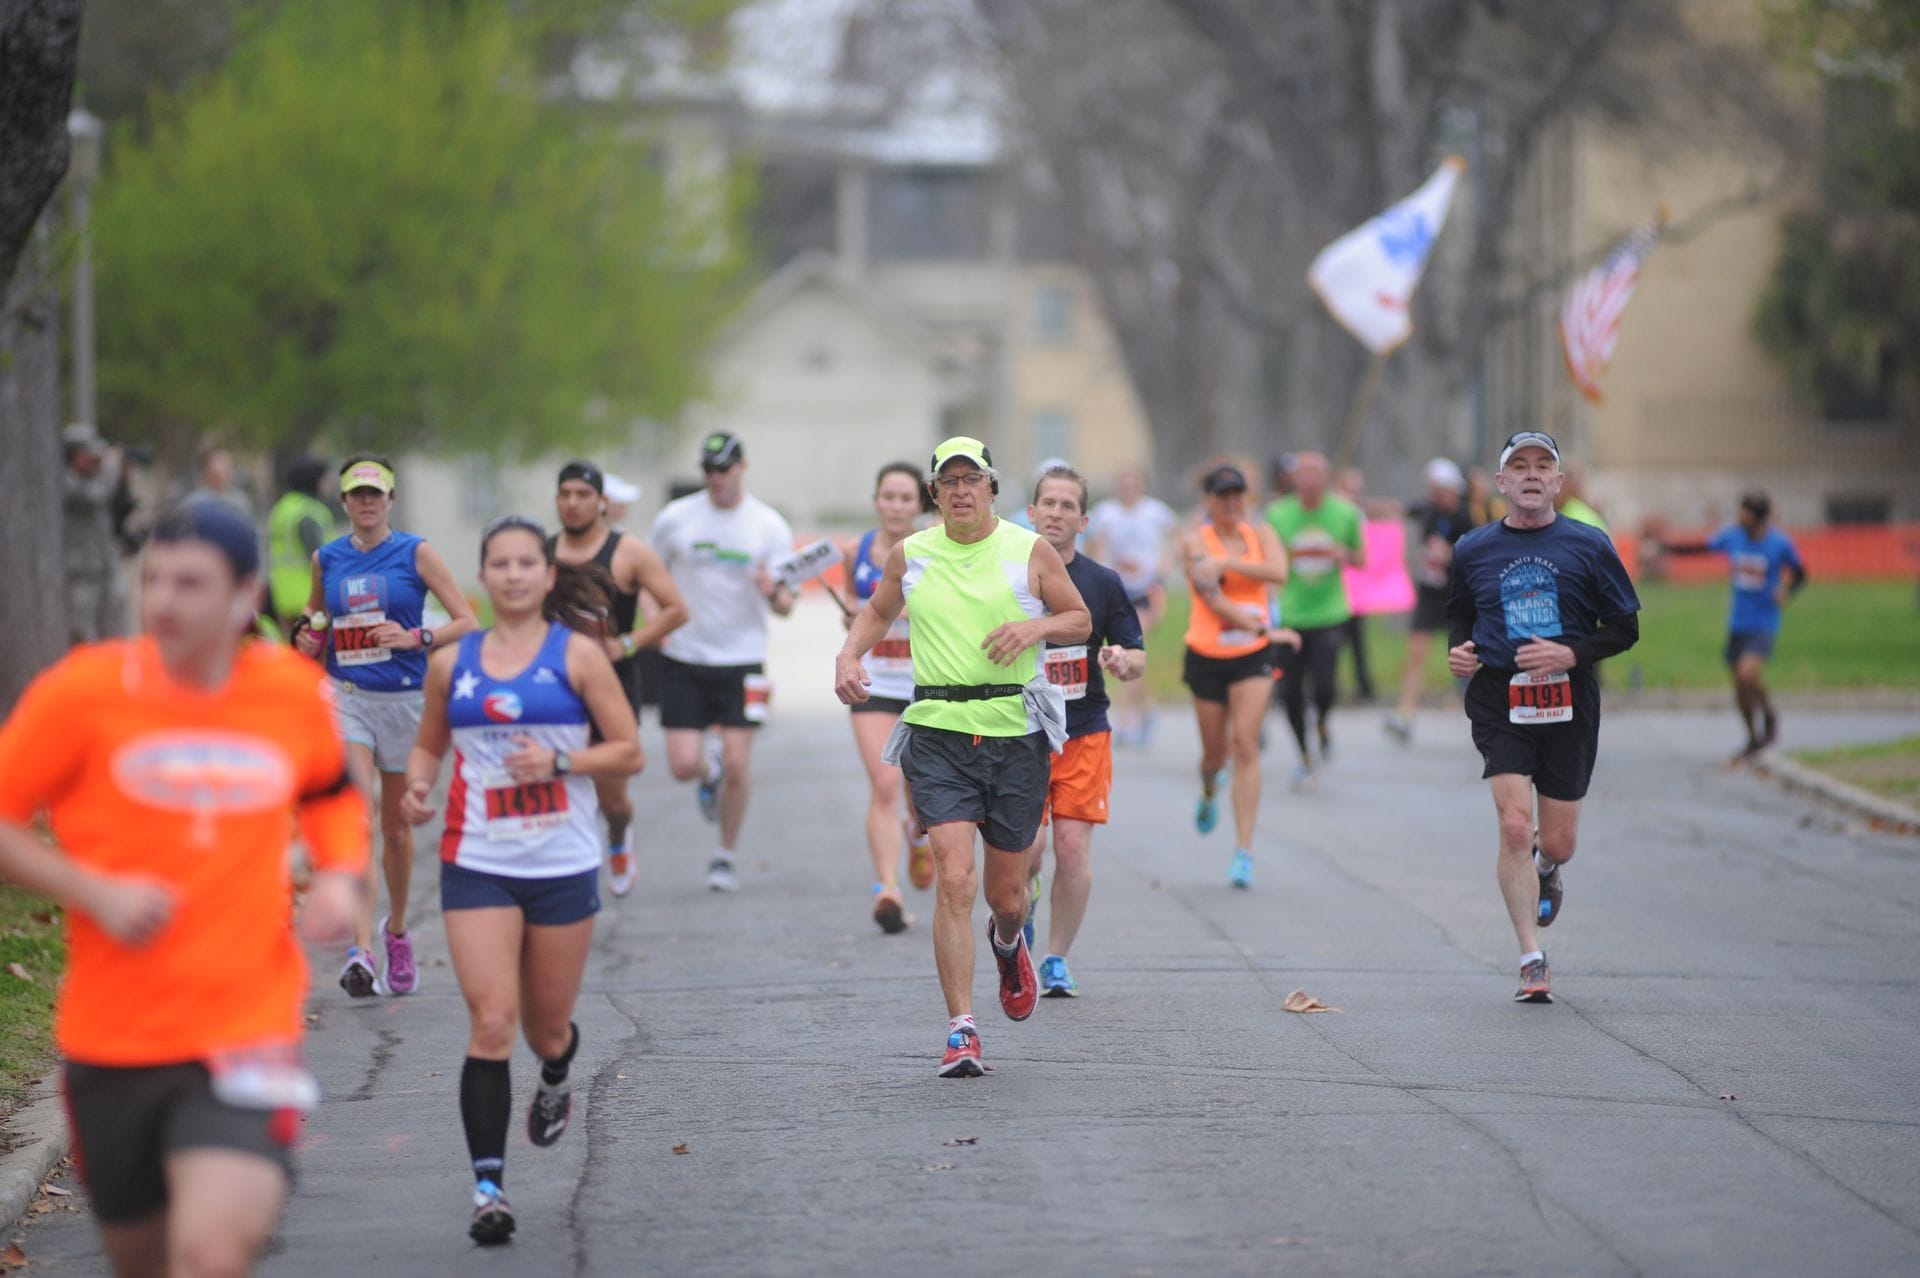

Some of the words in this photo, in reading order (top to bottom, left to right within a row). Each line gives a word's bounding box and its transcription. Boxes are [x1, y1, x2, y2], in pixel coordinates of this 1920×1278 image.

[1500, 556, 1531, 580] ALAMO
[1534, 556, 1560, 575] HALF
[347, 578, 367, 596] WE
[1509, 598, 1554, 611] ALAMO
[1510, 612, 1529, 624] RUN
[1533, 608, 1554, 623] FEST
[1049, 659, 1082, 685] 696
[1518, 682, 1564, 708] 1193
[496, 783, 555, 817] 1451
